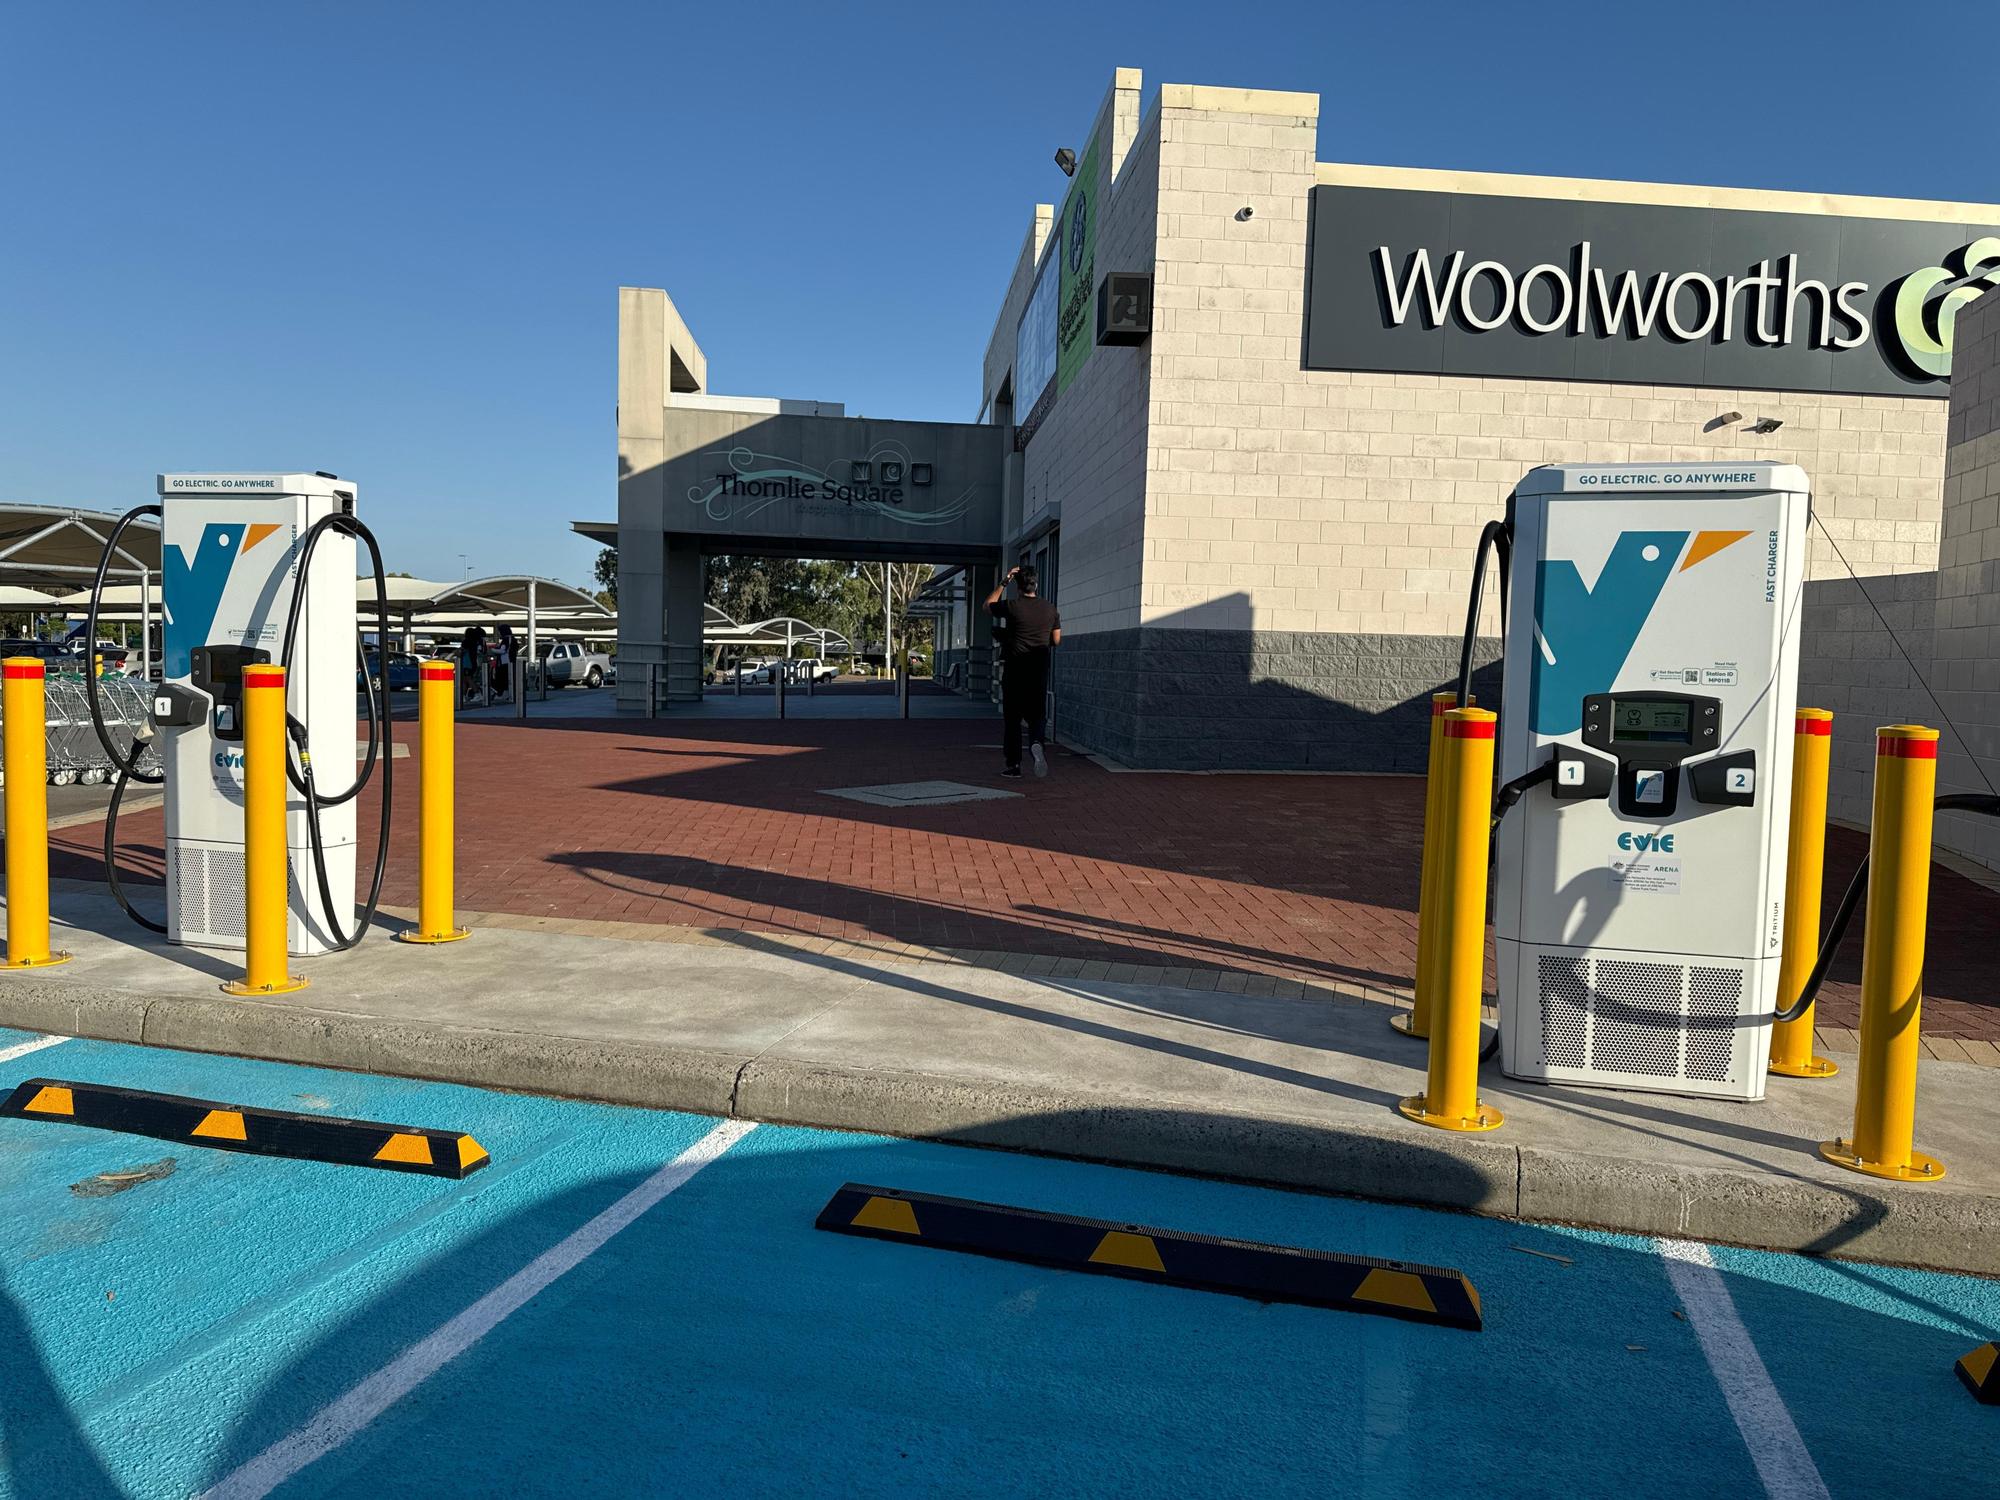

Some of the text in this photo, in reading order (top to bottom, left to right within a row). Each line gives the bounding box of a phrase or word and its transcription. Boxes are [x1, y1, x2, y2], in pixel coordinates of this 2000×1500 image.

[1377, 240, 1871, 350] Woolworths
[173, 480, 184, 488] GO
[221, 480, 233, 488] GO
[234, 480, 275, 488] ANYWHERE
[1579, 472, 1757, 485] GO ELECTRIC. GO ANYWHERE
[716, 472, 904, 507] Thornlie Square
[1765, 530, 1779, 603] FAST CHARGER
[161, 702, 166, 712] 1
[1567, 766, 1576, 780] 1
[1734, 774, 1746, 788] 2
